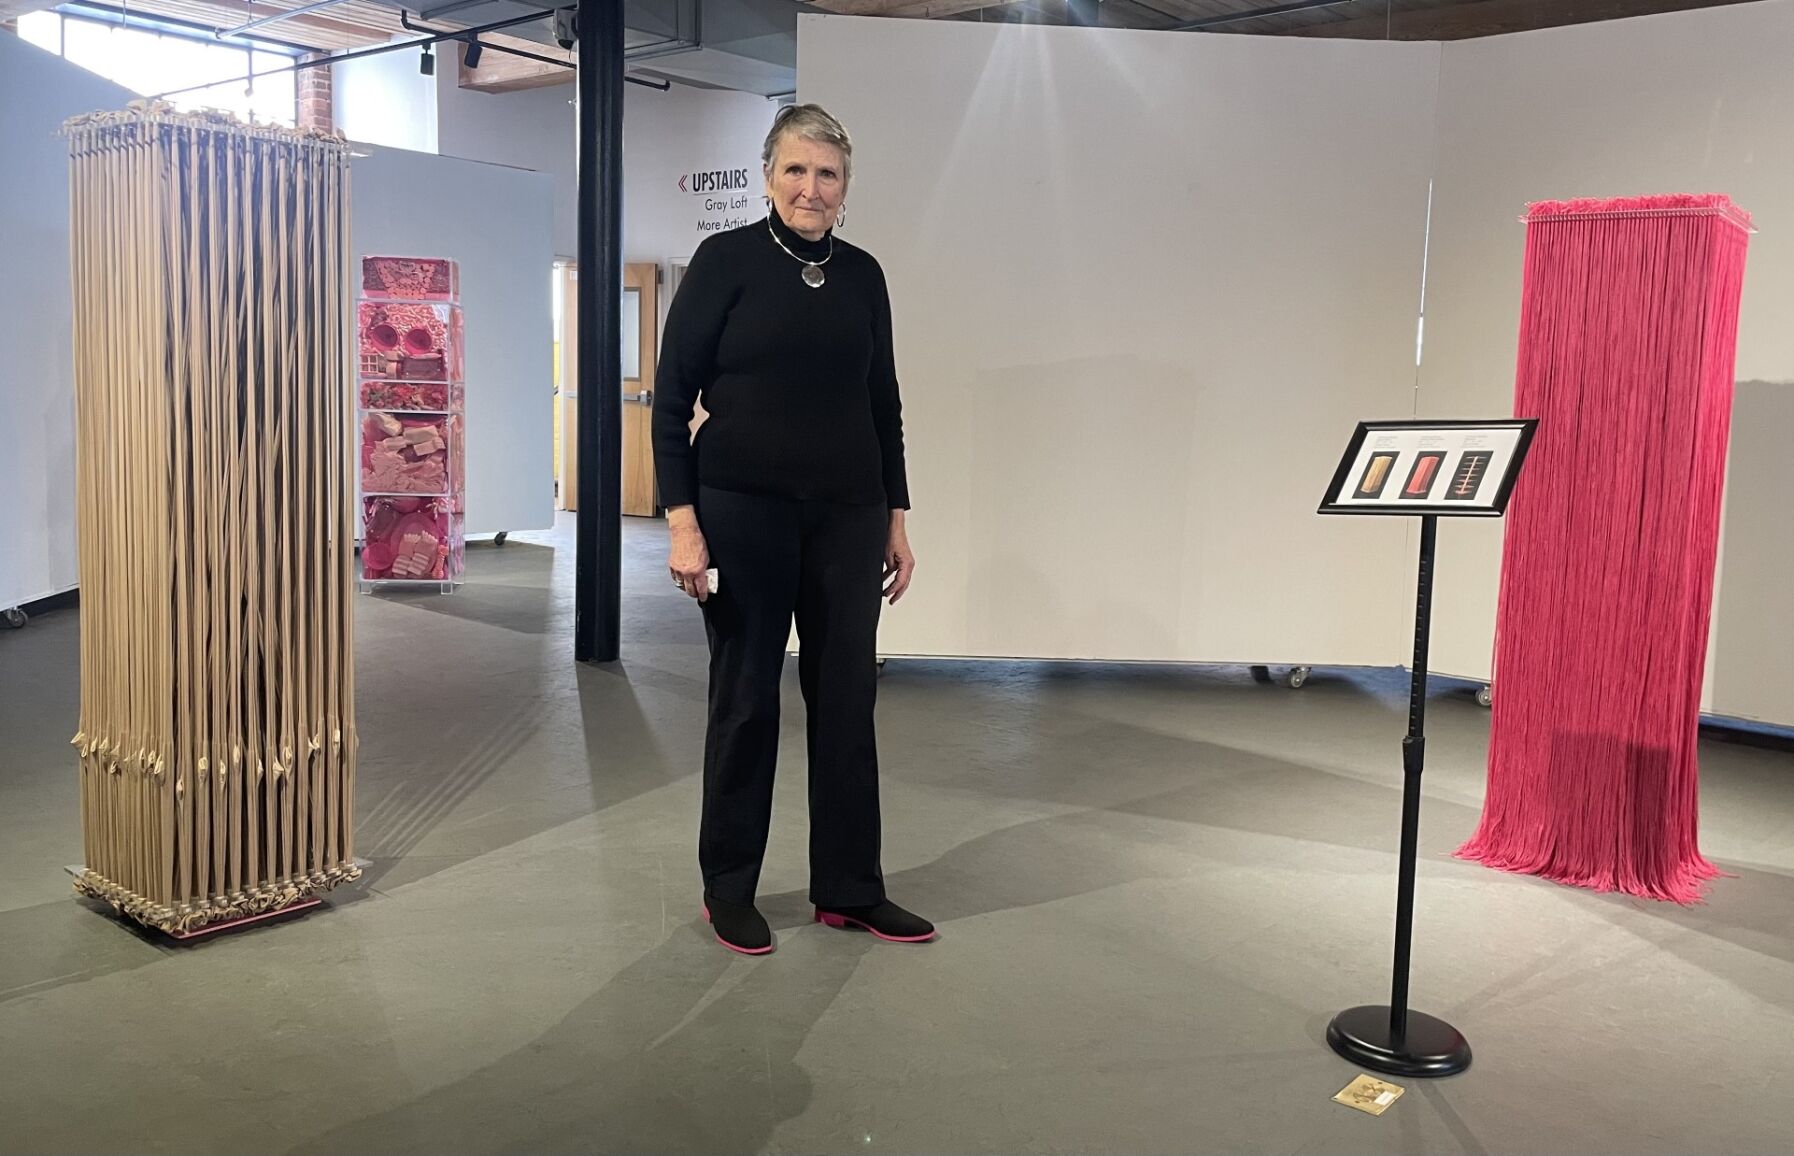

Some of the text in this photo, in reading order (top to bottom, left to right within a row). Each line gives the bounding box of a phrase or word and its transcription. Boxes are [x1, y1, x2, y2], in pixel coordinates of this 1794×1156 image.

[692, 168, 748, 192] UPSTAIRS
[704, 195, 748, 213] Gray Loft
[696, 216, 748, 232] More Artist
